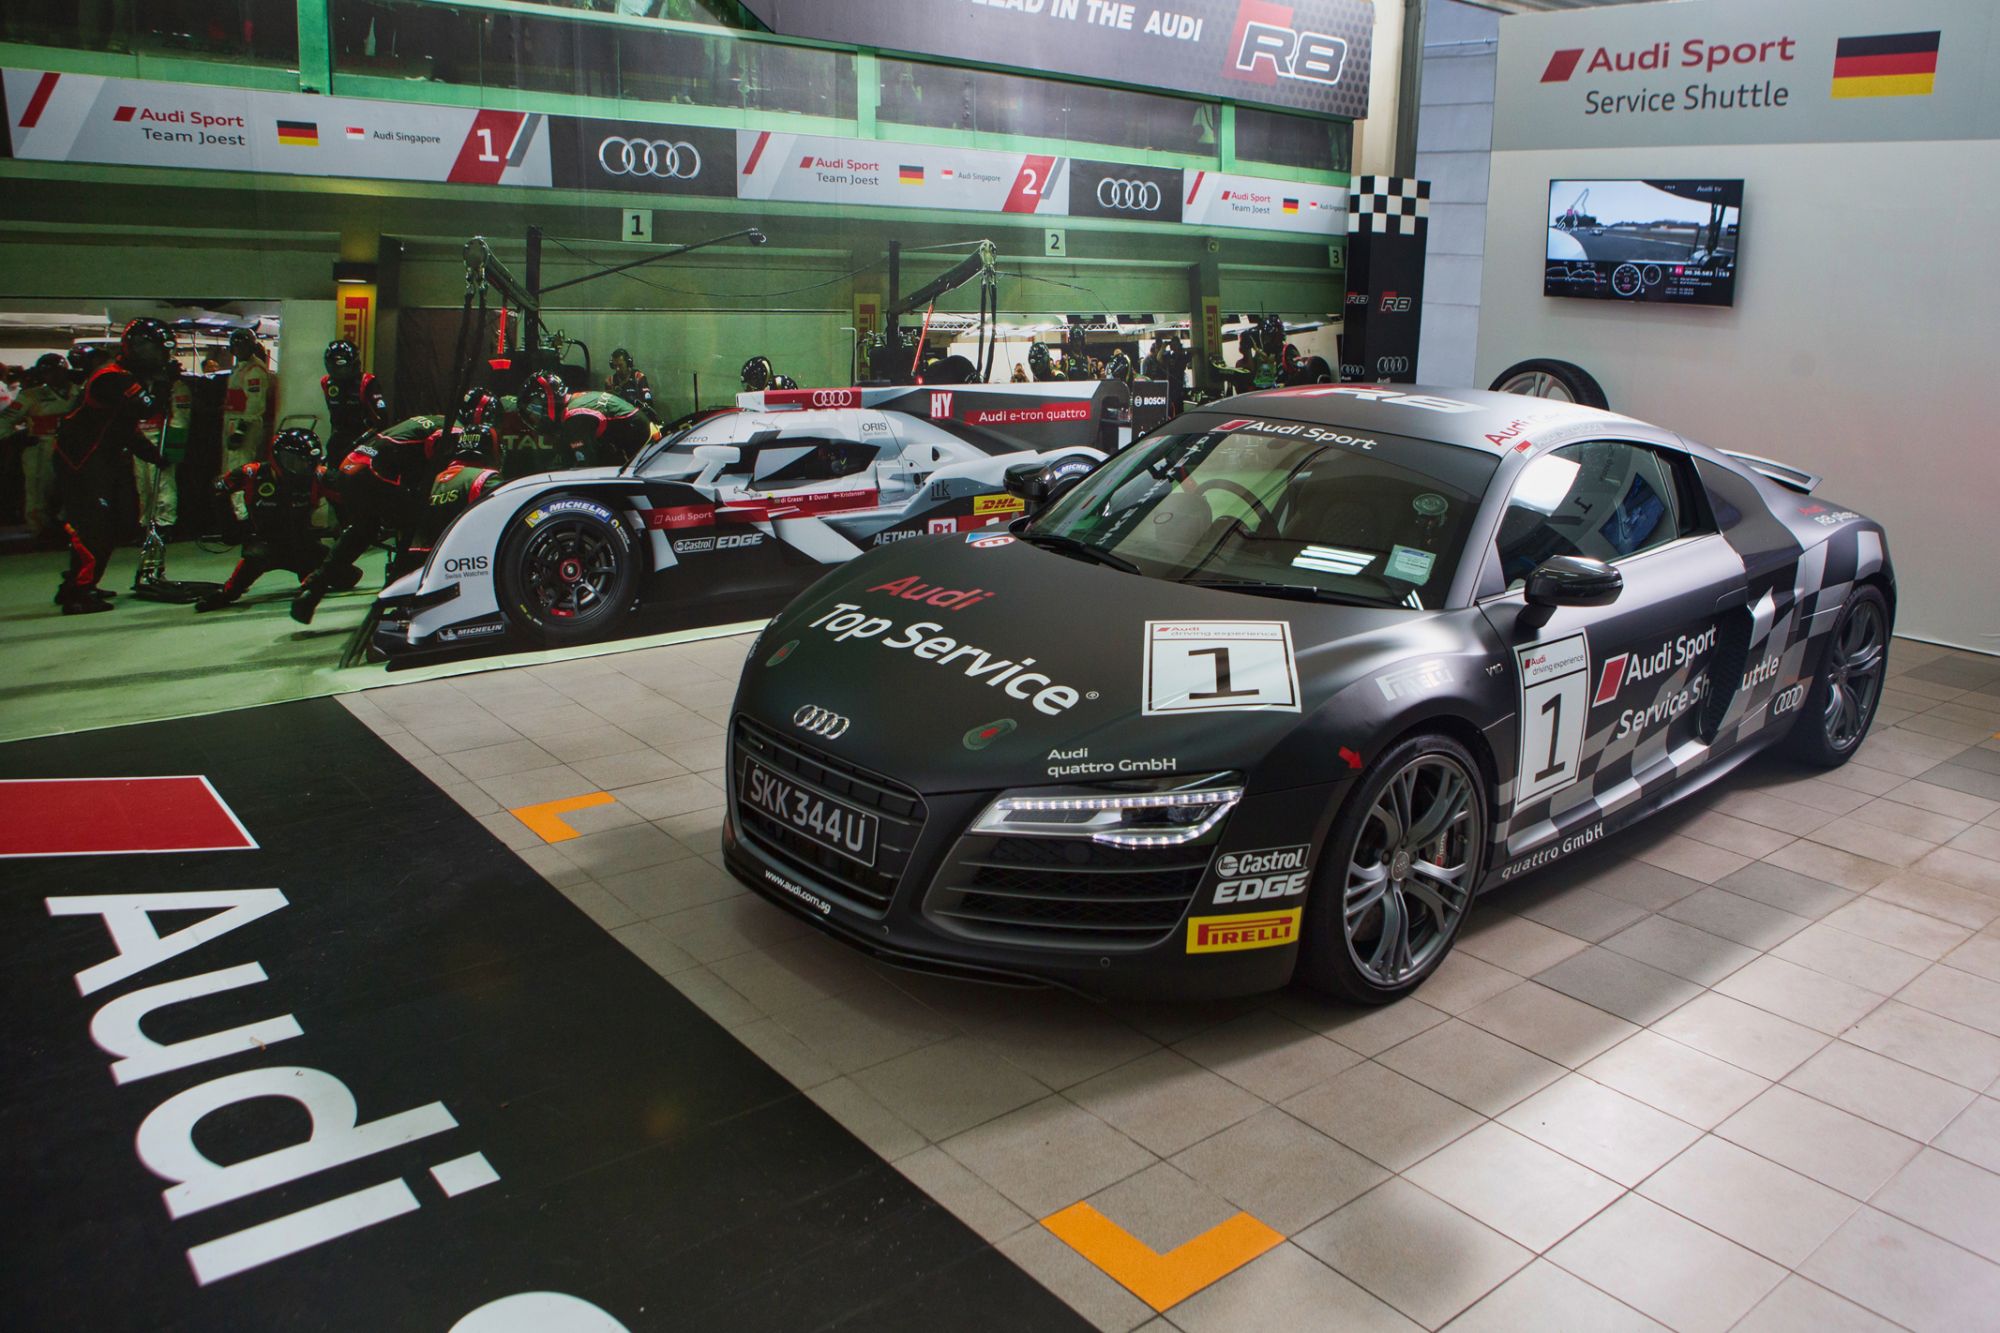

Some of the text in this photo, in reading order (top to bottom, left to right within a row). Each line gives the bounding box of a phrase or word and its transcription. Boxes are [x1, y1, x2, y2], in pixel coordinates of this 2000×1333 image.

[1050, 0, 1078, 20] IN
[1086, 3, 1134, 30] THE
[1144, 11, 1203, 42] AUDI
[1236, 21, 1347, 85] R8
[1586, 36, 1796, 73] Audi Sport
[1585, 80, 1789, 115] Service Shuttle
[140, 108, 245, 128] Audi Sport
[142, 127, 246, 146] Team Joest
[373, 130, 441, 144] Audi Singapore
[476, 128, 499, 162] 1
[815, 157, 879, 173] Audi Sport
[816, 172, 879, 186] Team Joest
[958, 171, 1001, 182] Audi Singapore
[1022, 168, 1037, 195] 2
[1231, 190, 1271, 205] Audi Sport
[1231, 203, 1271, 215] Team Joest
[631, 214, 644, 235] 1
[1050, 233, 1060, 250] 2
[1332, 249, 1340, 264] 3
[1380, 296, 1412, 312] R8
[931, 393, 953, 418] HY
[1143, 397, 1166, 405] BOSCH
[979, 408, 1087, 423] Audi e-tron quattro
[862, 422, 887, 432] ORIS
[1248, 420, 1378, 451] Audi Sport
[502, 435, 553, 450] TAL
[1061, 462, 1093, 475] MICHEL
[430, 489, 460, 506] TUS
[982, 498, 1017, 510] DHL
[549, 500, 610, 519] MICHELIN
[664, 511, 713, 524] Audi Sport
[683, 533, 764, 551] Castrol EDGE
[444, 555, 488, 573] ORIS
[866, 575, 998, 612] Audi
[808, 603, 1080, 716] Top Service
[1530, 654, 1547, 667] Audi
[1532, 653, 1584, 677] driving experience
[1625, 624, 1717, 686] Audi Sport
[1188, 647, 1260, 700] 1
[1616, 690, 1690, 740] Service
[1534, 692, 1566, 784] 1
[1047, 747, 1089, 760] Audi
[1047, 757, 1177, 778] quattro GmbH
[1238, 847, 1304, 875] Castrol
[1501, 822, 1605, 880] quattro GmbH
[764, 869, 832, 915] www.audi.com.sg
[1212, 870, 1311, 905] EDGE
[1197, 916, 1294, 946] PIRELLI
[45, 887, 501, 1287] Audi
